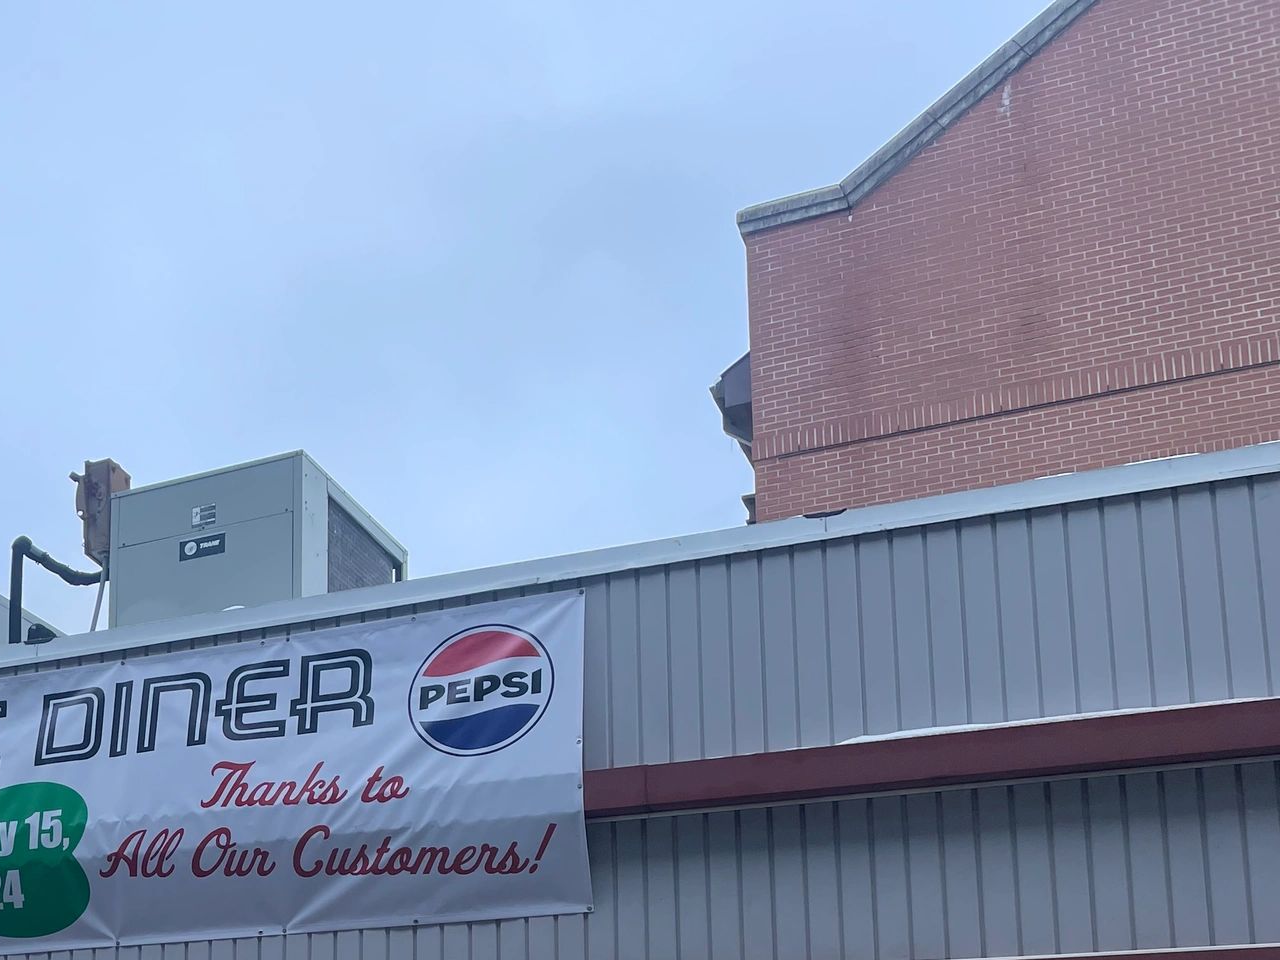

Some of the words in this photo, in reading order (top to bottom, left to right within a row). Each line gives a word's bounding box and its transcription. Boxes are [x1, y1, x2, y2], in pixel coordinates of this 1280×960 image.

[34, 648, 375, 766] DINER
[418, 668, 542, 711] PEPSI
[200, 760, 350, 809] Thanks
[361, 765, 410, 803] to
[24, 808, 71, 852] 15,
[99, 827, 185, 880] All
[191, 826, 276, 880] Our
[293, 822, 558, 880] Customers!
